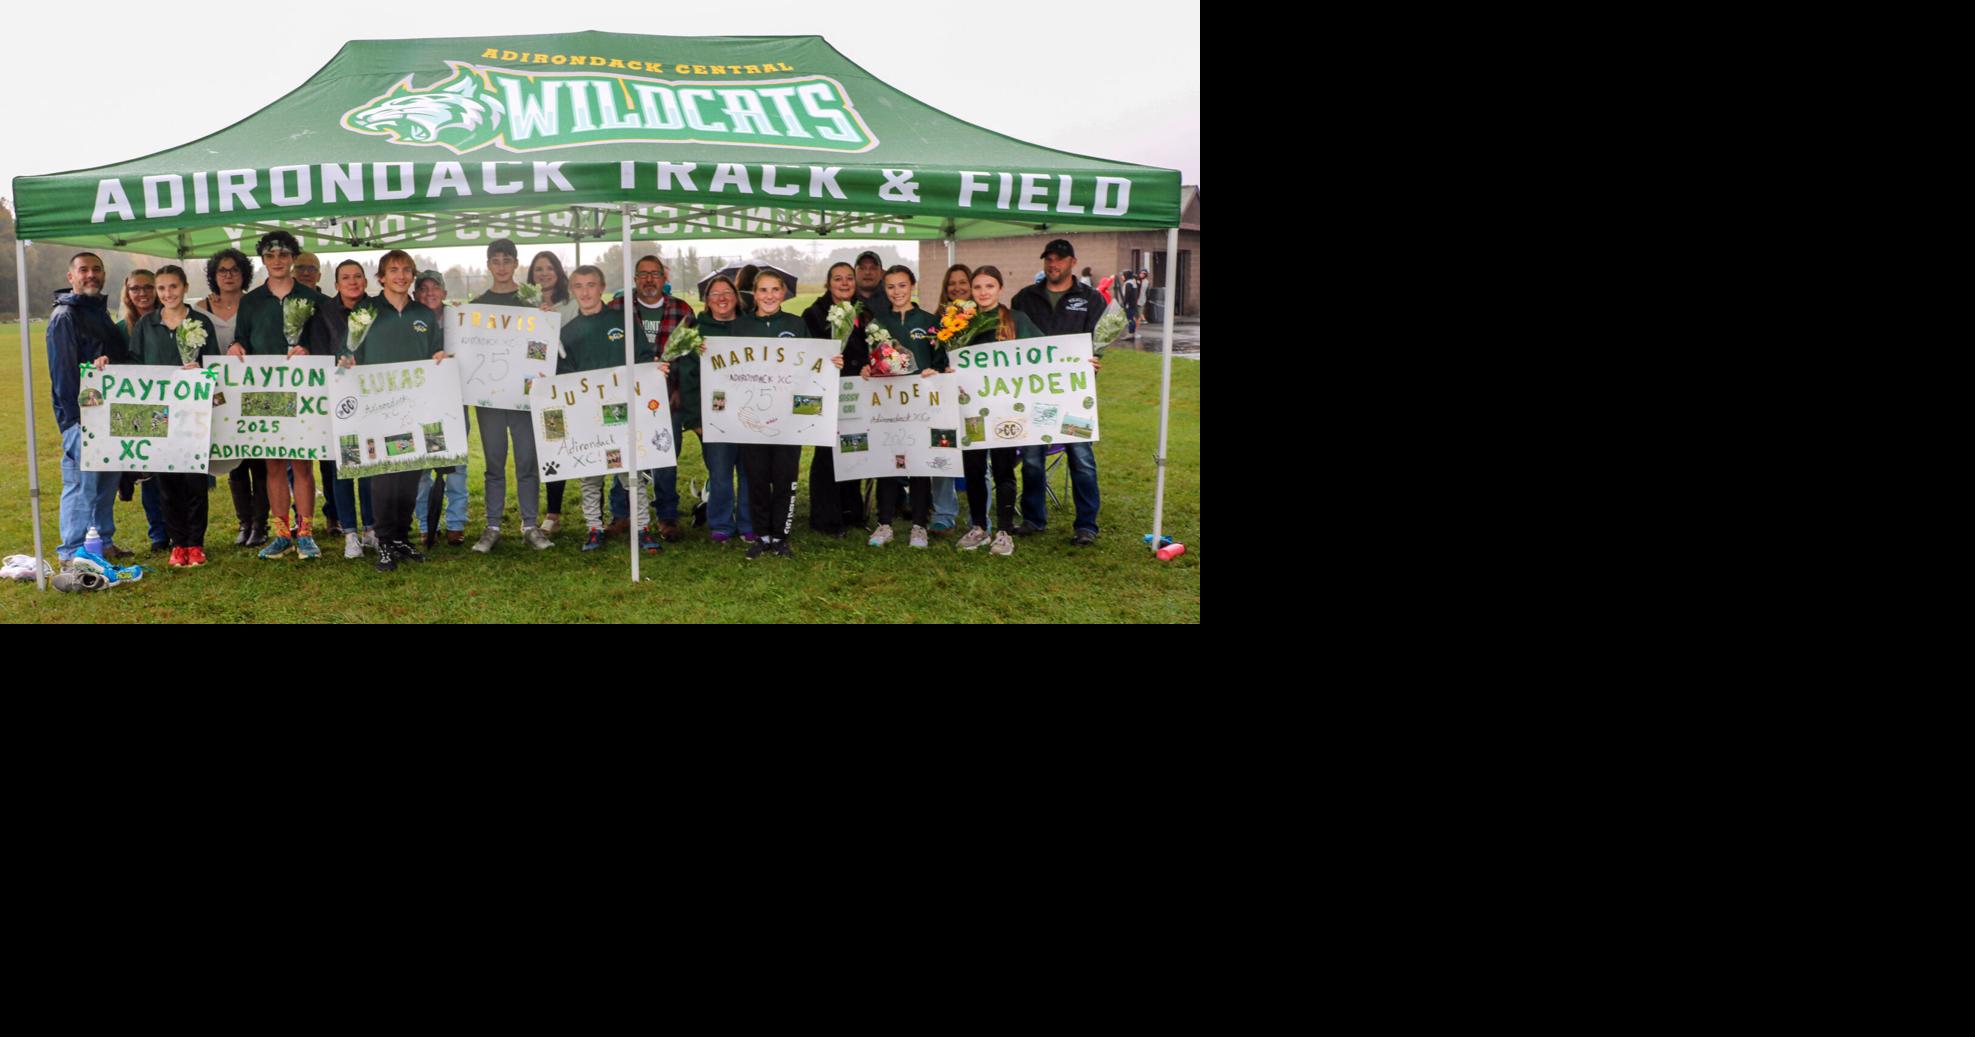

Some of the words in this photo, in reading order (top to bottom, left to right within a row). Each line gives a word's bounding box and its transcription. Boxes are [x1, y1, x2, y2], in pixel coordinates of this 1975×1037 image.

[482, 48, 663, 73] ADIRONDACK
[675, 62, 794, 75] CENTRAL
[497, 76, 863, 144] WILDCATS
[91, 160, 575, 223] ADIRONDACK
[620, 160, 848, 199] TRACK
[878, 168, 921, 203] &
[958, 170, 1133, 216] FIELD
[457, 312, 537, 332] TRAVIS
[710, 345, 823, 374] MARISSA
[101, 374, 211, 401] PAYTON
[208, 362, 326, 388] CLAYTON
[358, 367, 425, 395] LUKAS
[777, 374, 793, 385] XC
[977, 371, 1087, 398] JAYDEN
[299, 395, 328, 416] XC
[871, 383, 940, 407] AYDEN
[236, 419, 281, 434] 2025
[118, 439, 152, 461] XC
[209, 443, 327, 460] ADIRONDACK!
